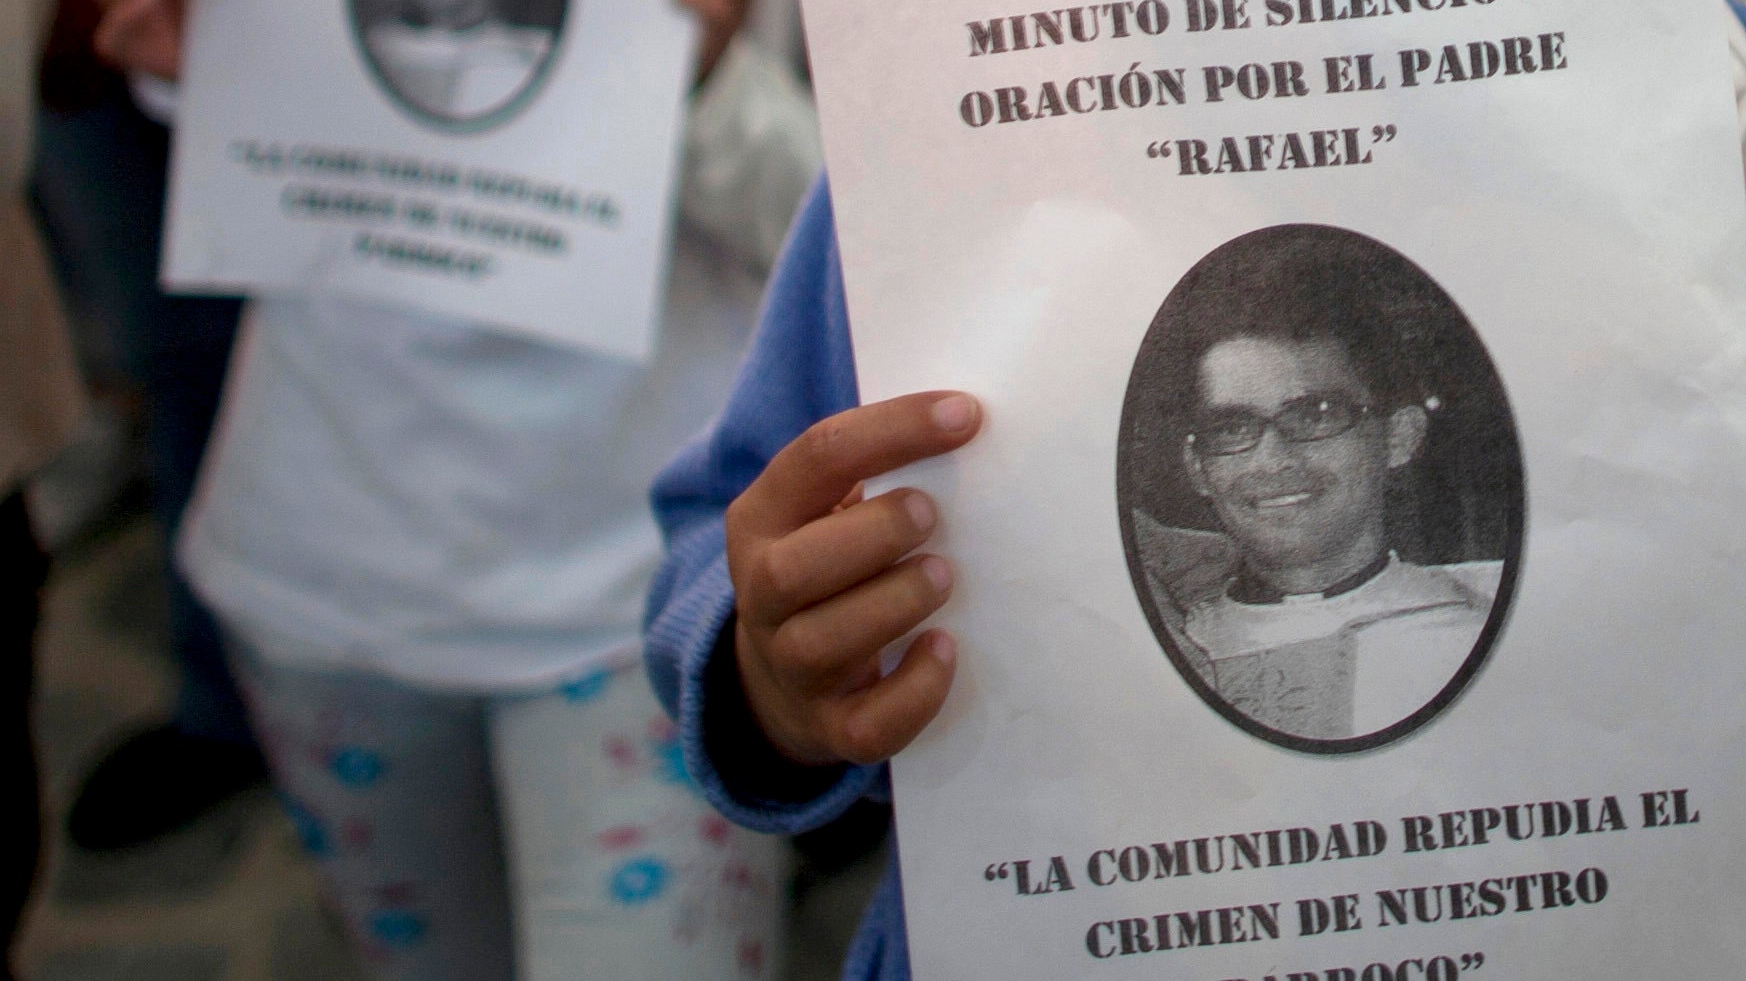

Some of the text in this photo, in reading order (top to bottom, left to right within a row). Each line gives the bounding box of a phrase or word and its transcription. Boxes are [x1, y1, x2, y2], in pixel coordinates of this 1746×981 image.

[959, 31, 1568, 128] ORACIÓN POR EL PADRE
[1086, 820, 1388, 887] COMUNIDAD
[1400, 795, 1628, 854] REPUDIA
[1639, 788, 1700, 829] EL
[1085, 867, 1609, 959] CRIMEN DE NUESTRO
